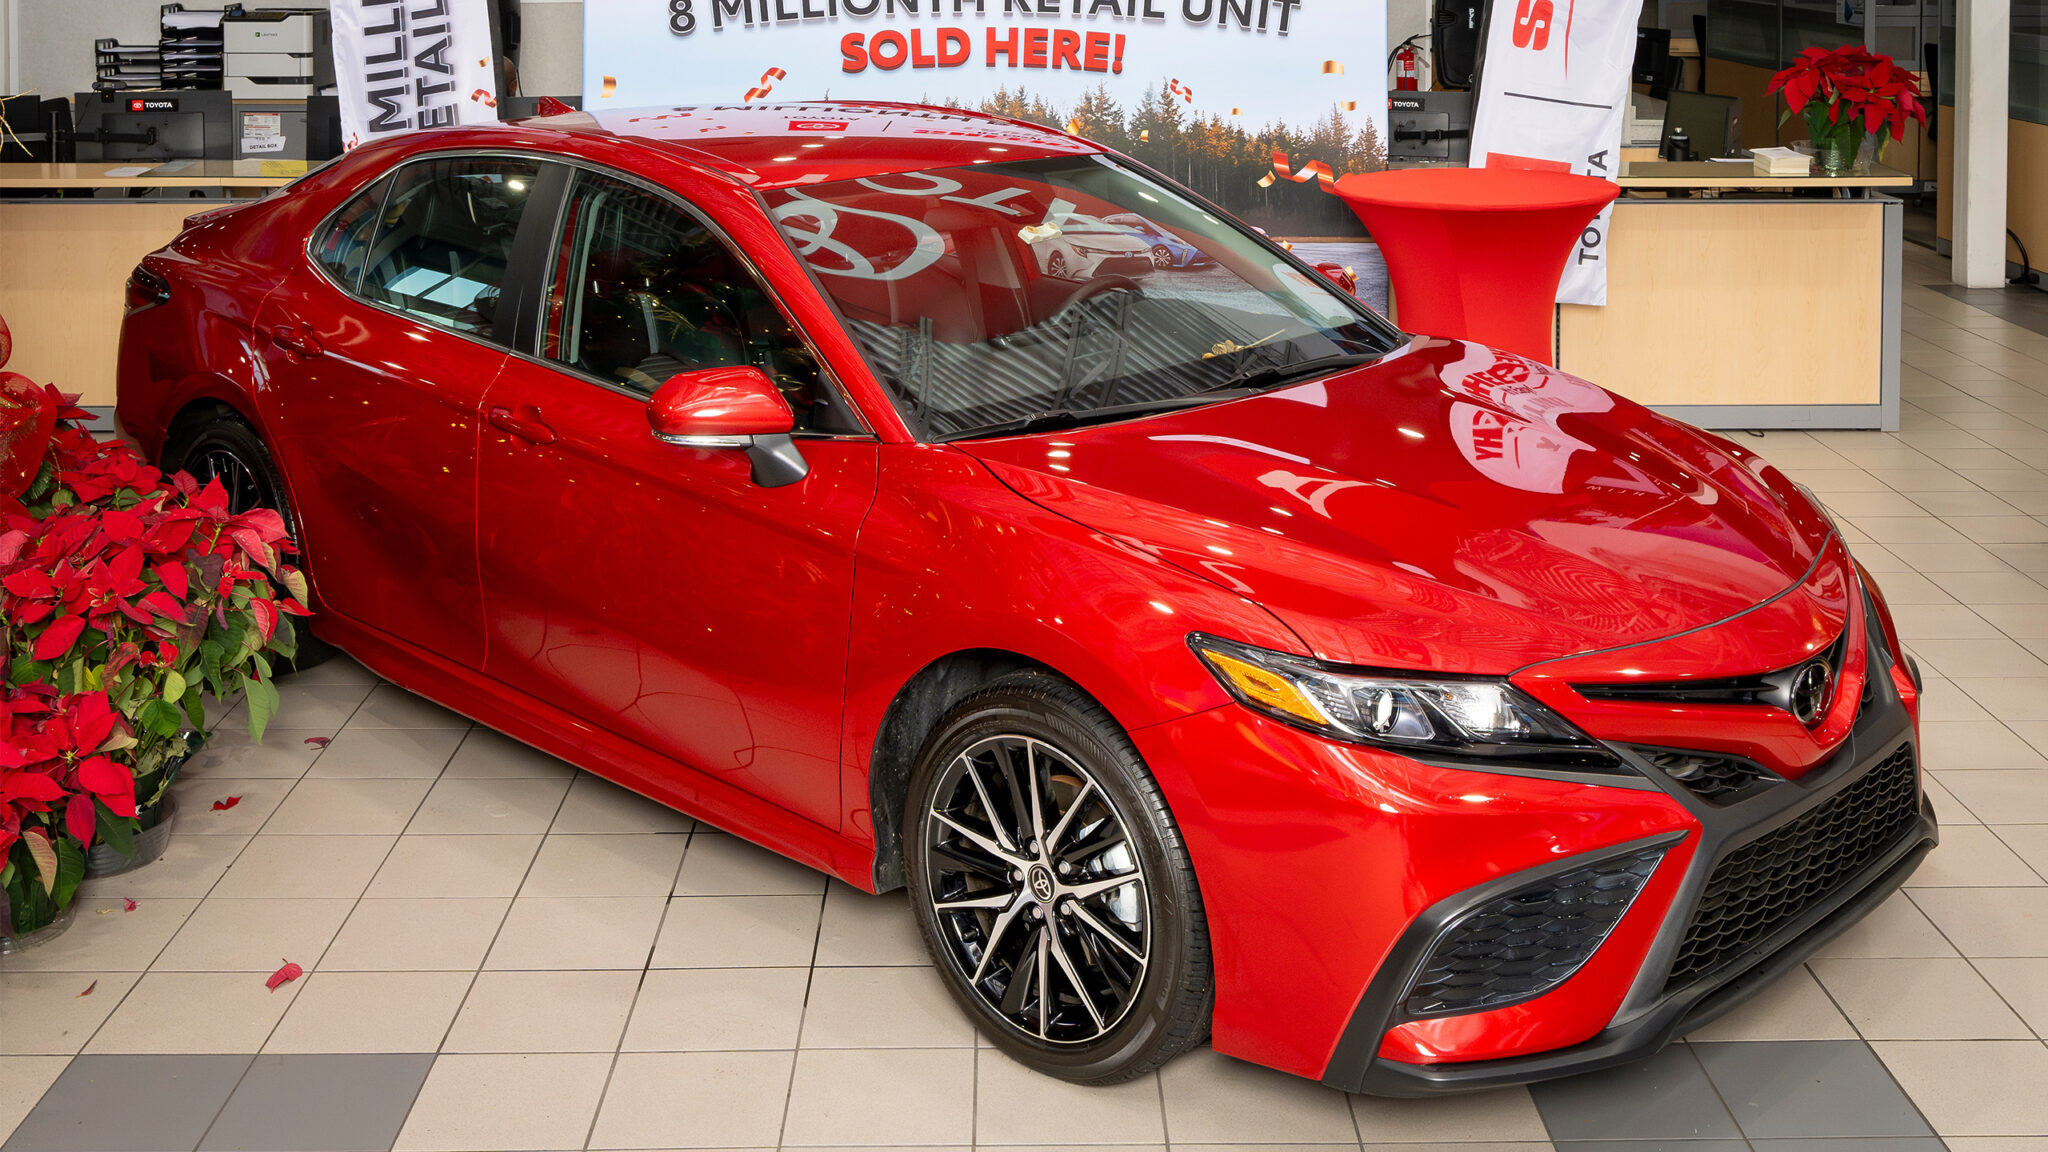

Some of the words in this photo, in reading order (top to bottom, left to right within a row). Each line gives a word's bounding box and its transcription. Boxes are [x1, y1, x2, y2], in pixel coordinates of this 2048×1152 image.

[668, 0, 696, 36] 8
[1181, 0, 1301, 36] UNIT
[840, 27, 971, 74] SOLD
[985, 27, 1126, 75] HERE!
[1578, 149, 1608, 265] TOA
